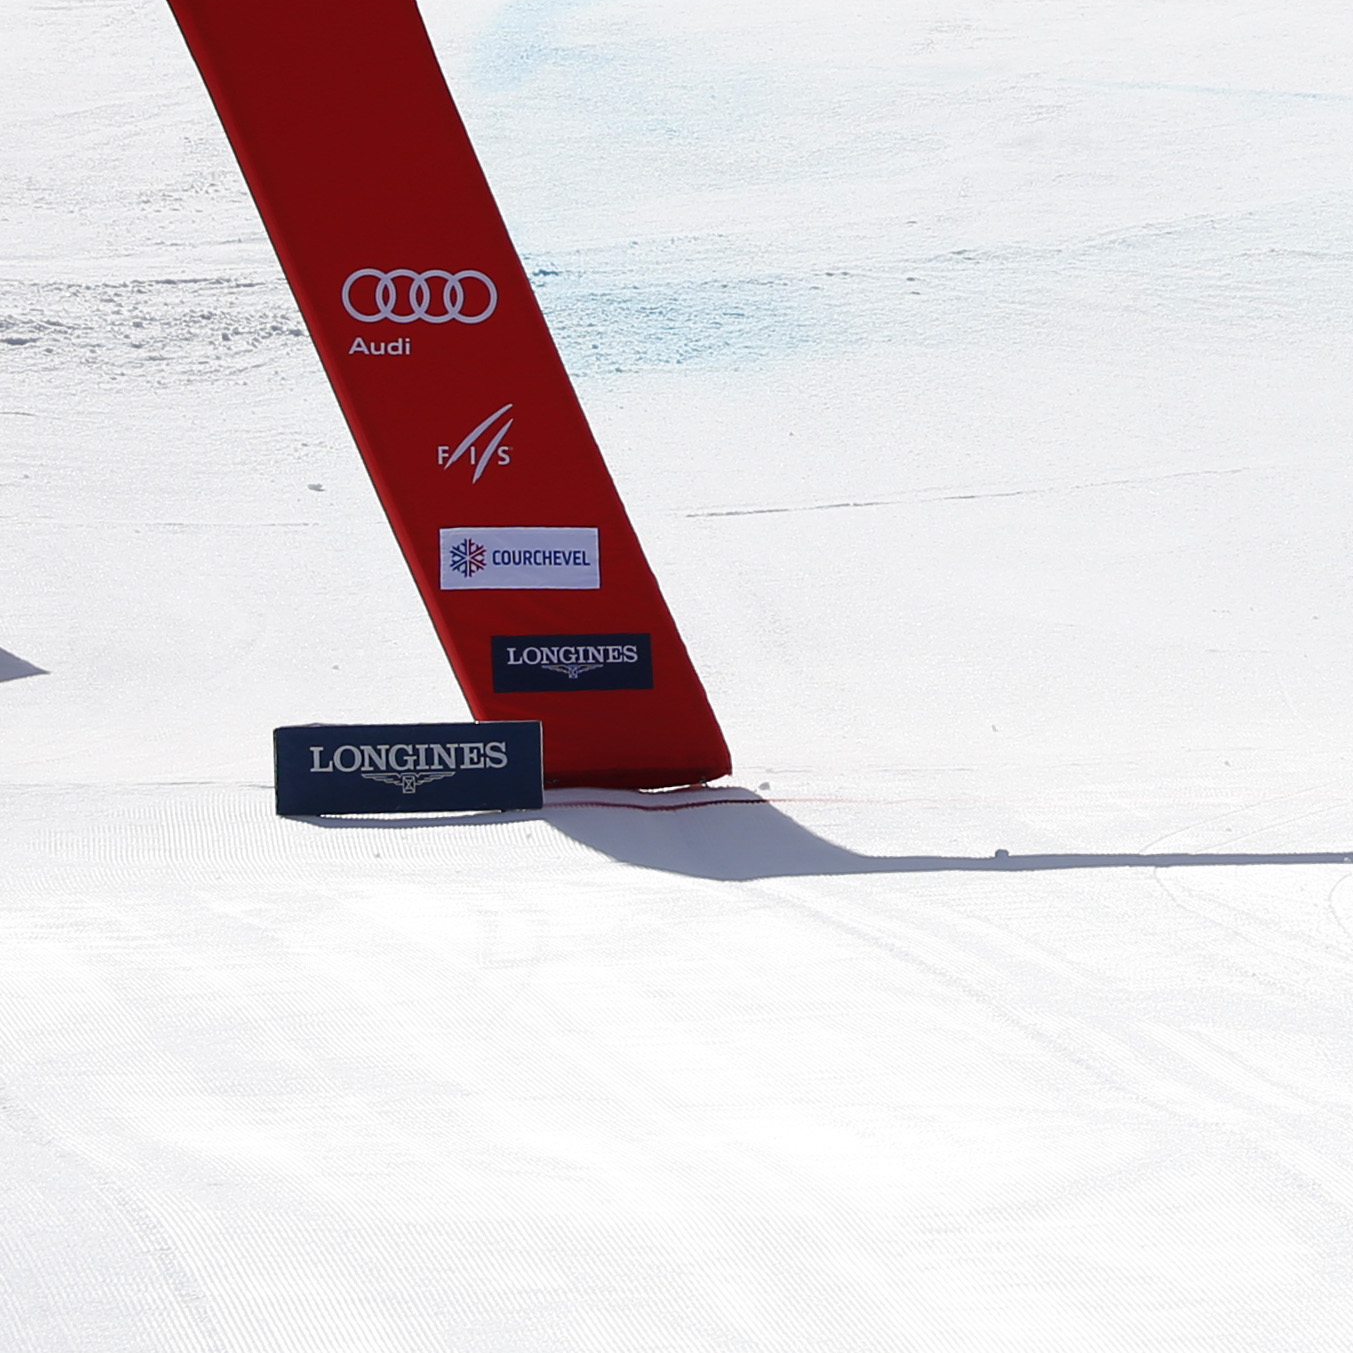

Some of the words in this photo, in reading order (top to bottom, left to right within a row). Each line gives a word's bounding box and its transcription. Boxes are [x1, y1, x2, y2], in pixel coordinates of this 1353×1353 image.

[348, 337, 411, 355] Audi
[492, 549, 591, 567] COURCHEVEL
[507, 646, 638, 665] LONGINES
[310, 742, 507, 773] LONGINES
